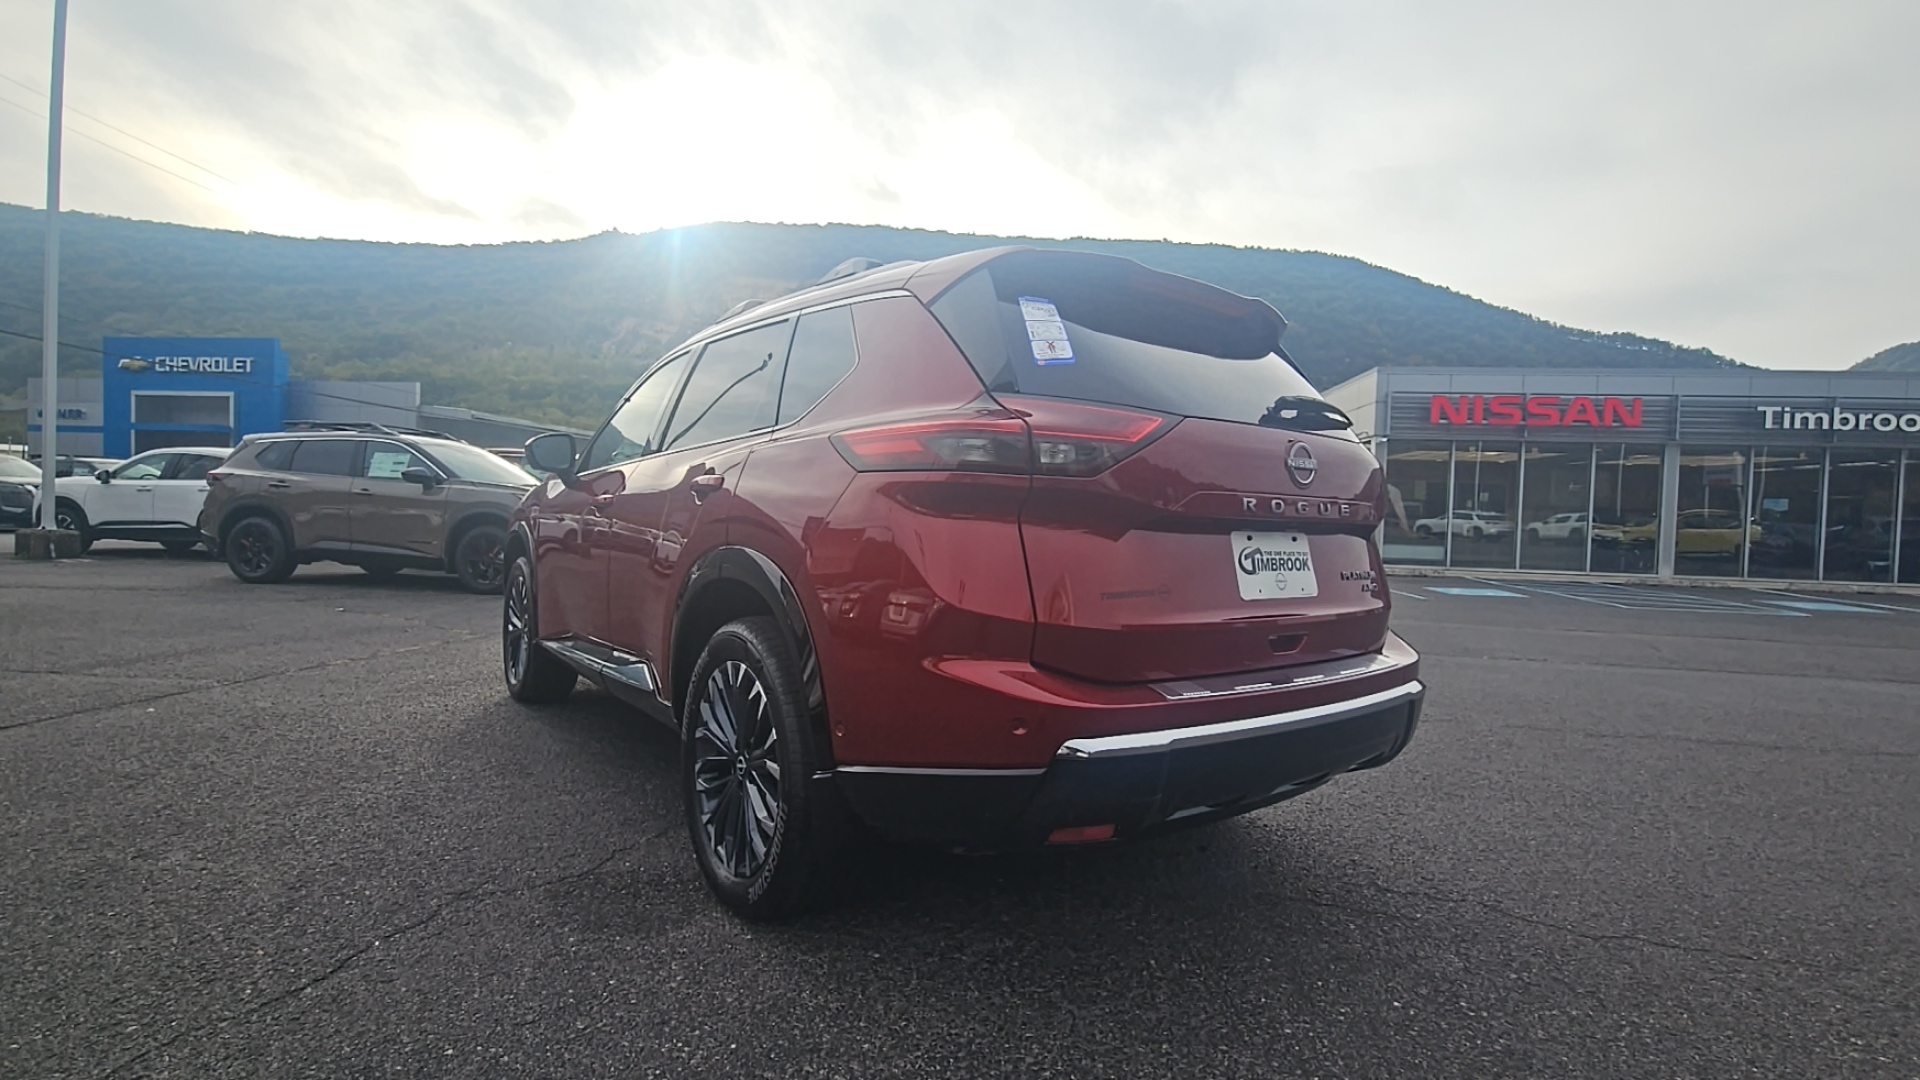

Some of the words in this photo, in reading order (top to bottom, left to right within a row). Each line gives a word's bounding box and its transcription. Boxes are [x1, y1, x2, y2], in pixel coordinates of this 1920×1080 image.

[155, 356, 254, 373] CHEVROLET
[1430, 394, 1643, 428] NISSAN
[1757, 405, 1920, 432] Timbroo
[1243, 497, 1350, 516] ROGUE
[1238, 547, 1311, 575] TIMBROOK
